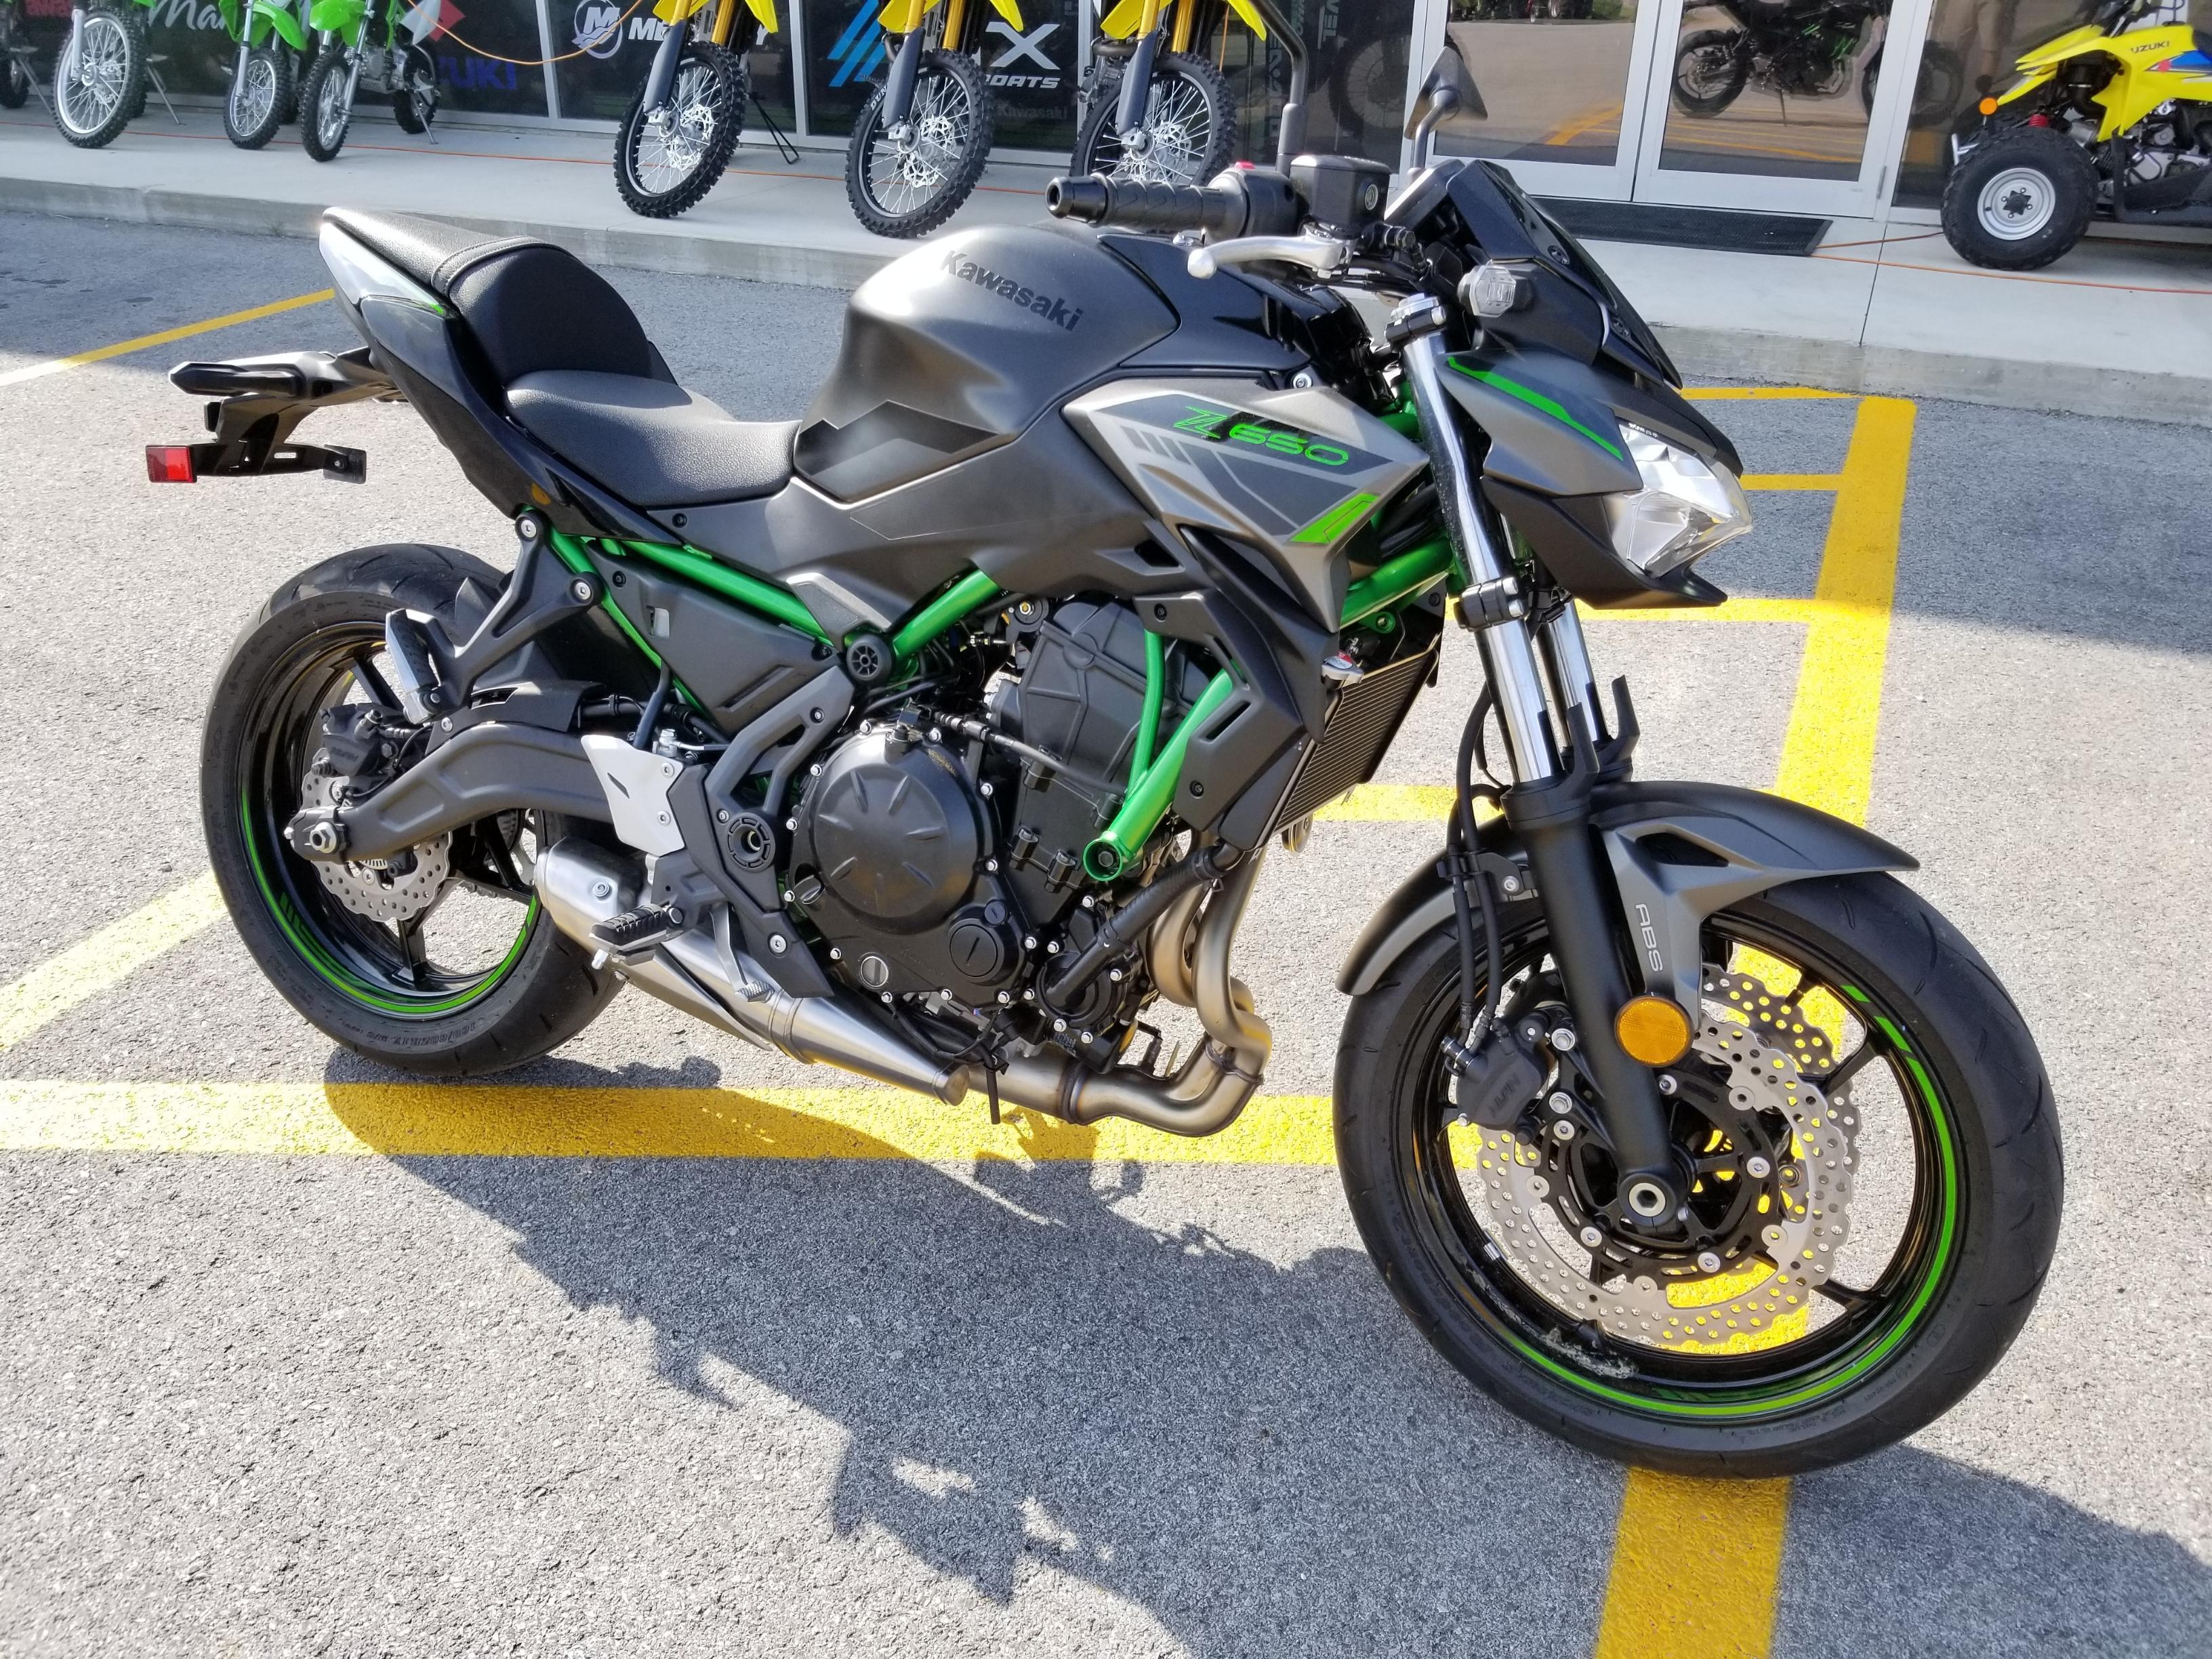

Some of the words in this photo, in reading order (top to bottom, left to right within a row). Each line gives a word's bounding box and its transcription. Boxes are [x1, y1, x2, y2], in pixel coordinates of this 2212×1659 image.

[2131, 41, 2170, 54] UZUKI
[438, 57, 516, 90] ZUKI
[870, 84, 887, 110] DUN
[940, 250, 1084, 331] Kawasaki
[1635, 903, 1664, 972] ABS
